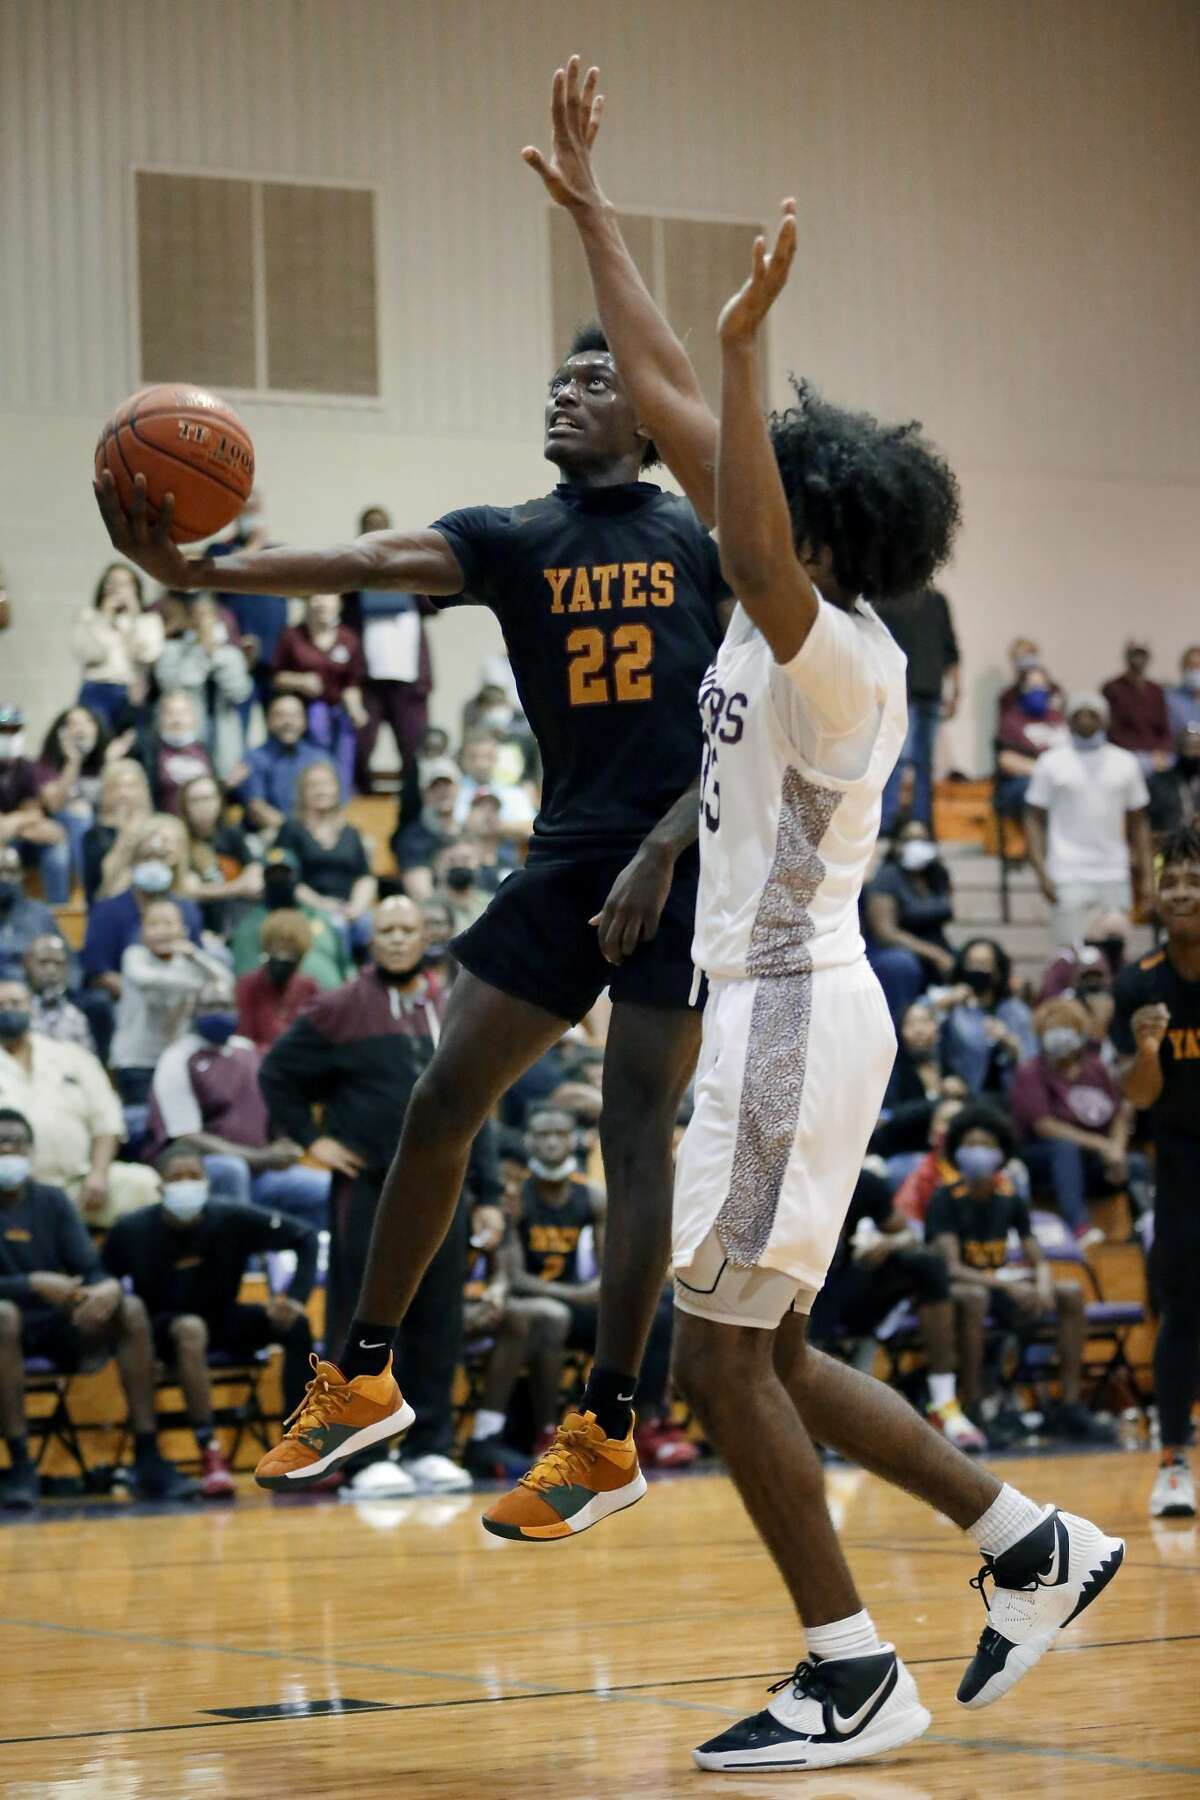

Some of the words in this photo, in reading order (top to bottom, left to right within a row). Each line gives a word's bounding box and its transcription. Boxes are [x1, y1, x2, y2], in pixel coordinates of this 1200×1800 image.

[178, 419, 211, 444] TF
[543, 562, 675, 614] YATES
[566, 624, 654, 705] 22
